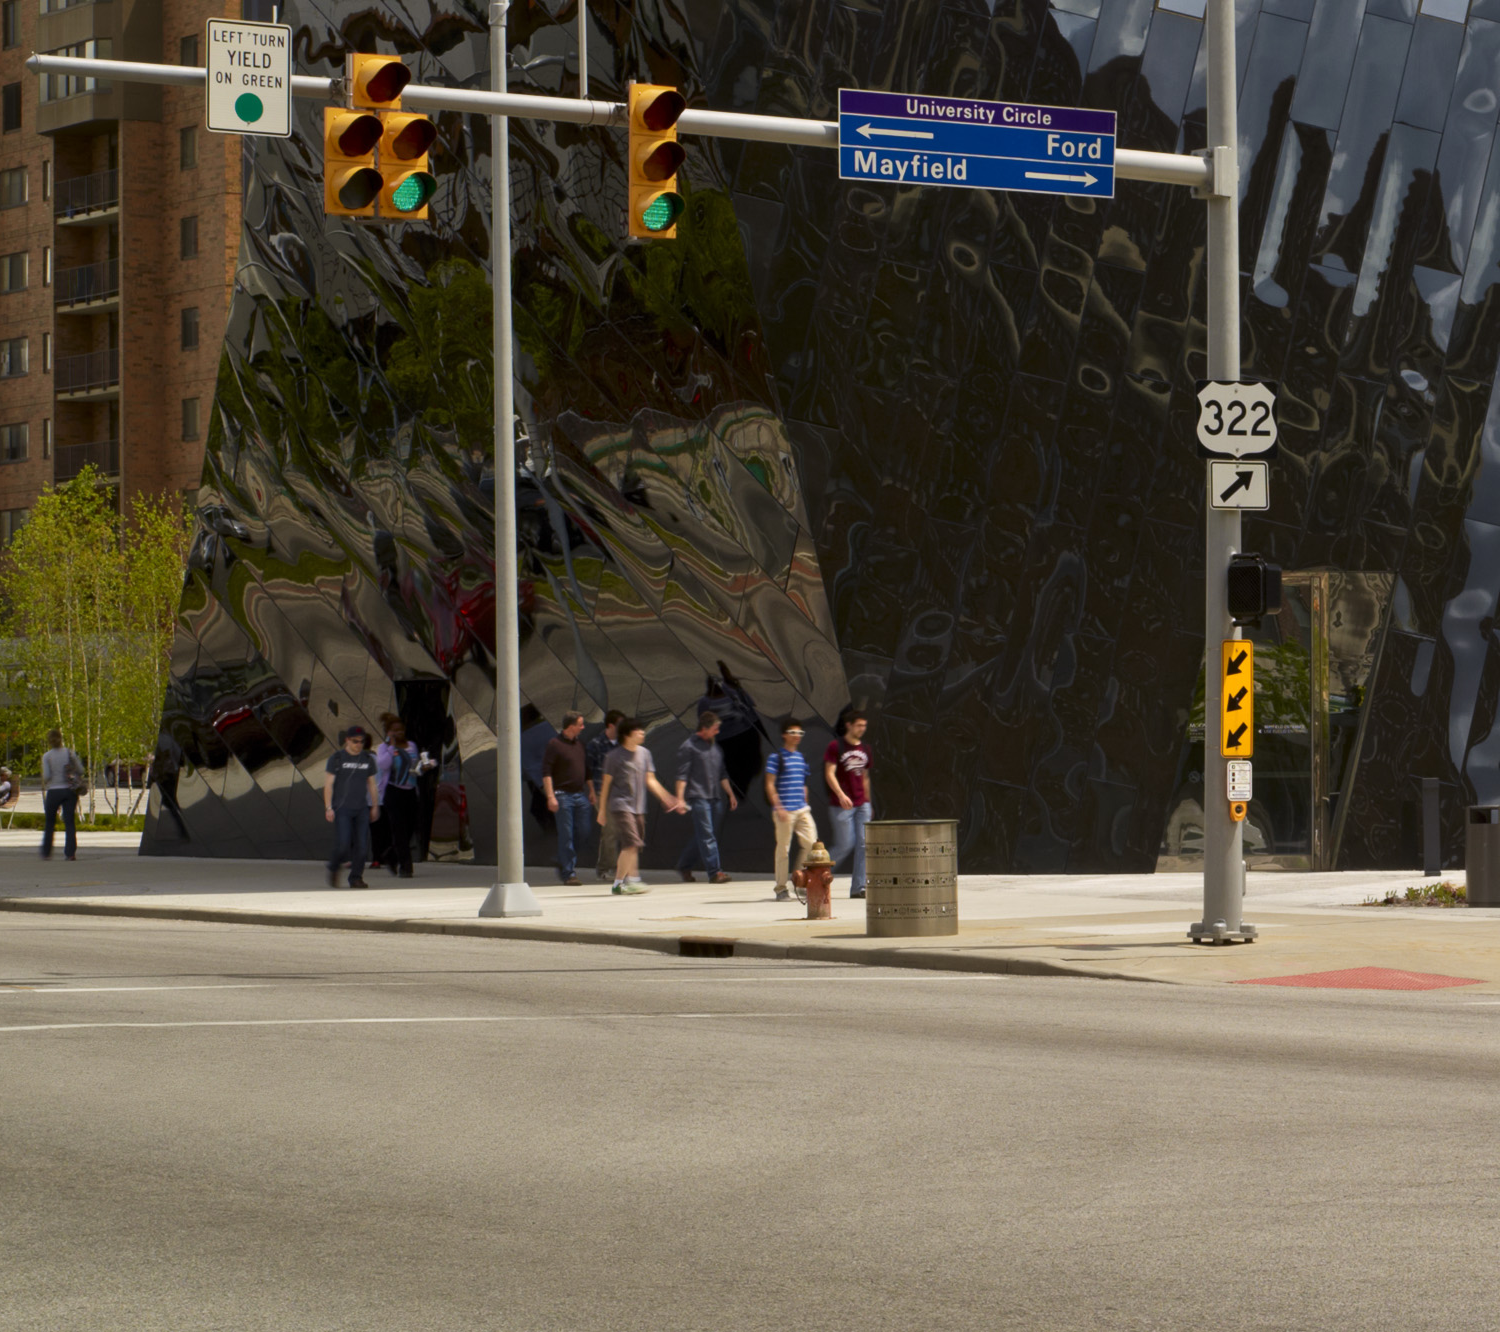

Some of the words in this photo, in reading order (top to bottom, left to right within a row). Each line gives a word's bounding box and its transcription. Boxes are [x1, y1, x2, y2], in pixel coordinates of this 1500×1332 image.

[214, 29, 243, 44] LEFT
[253, 33, 285, 48] TURN
[227, 49, 272, 69] YIELD
[215, 71, 232, 85] ON
[242, 73, 282, 89] GREEN
[905, 98, 996, 124] University
[1002, 106, 1052, 125] Circle
[1047, 133, 1102, 160] Ford
[854, 150, 967, 181] Mayfield
[1203, 399, 1271, 437] 322
